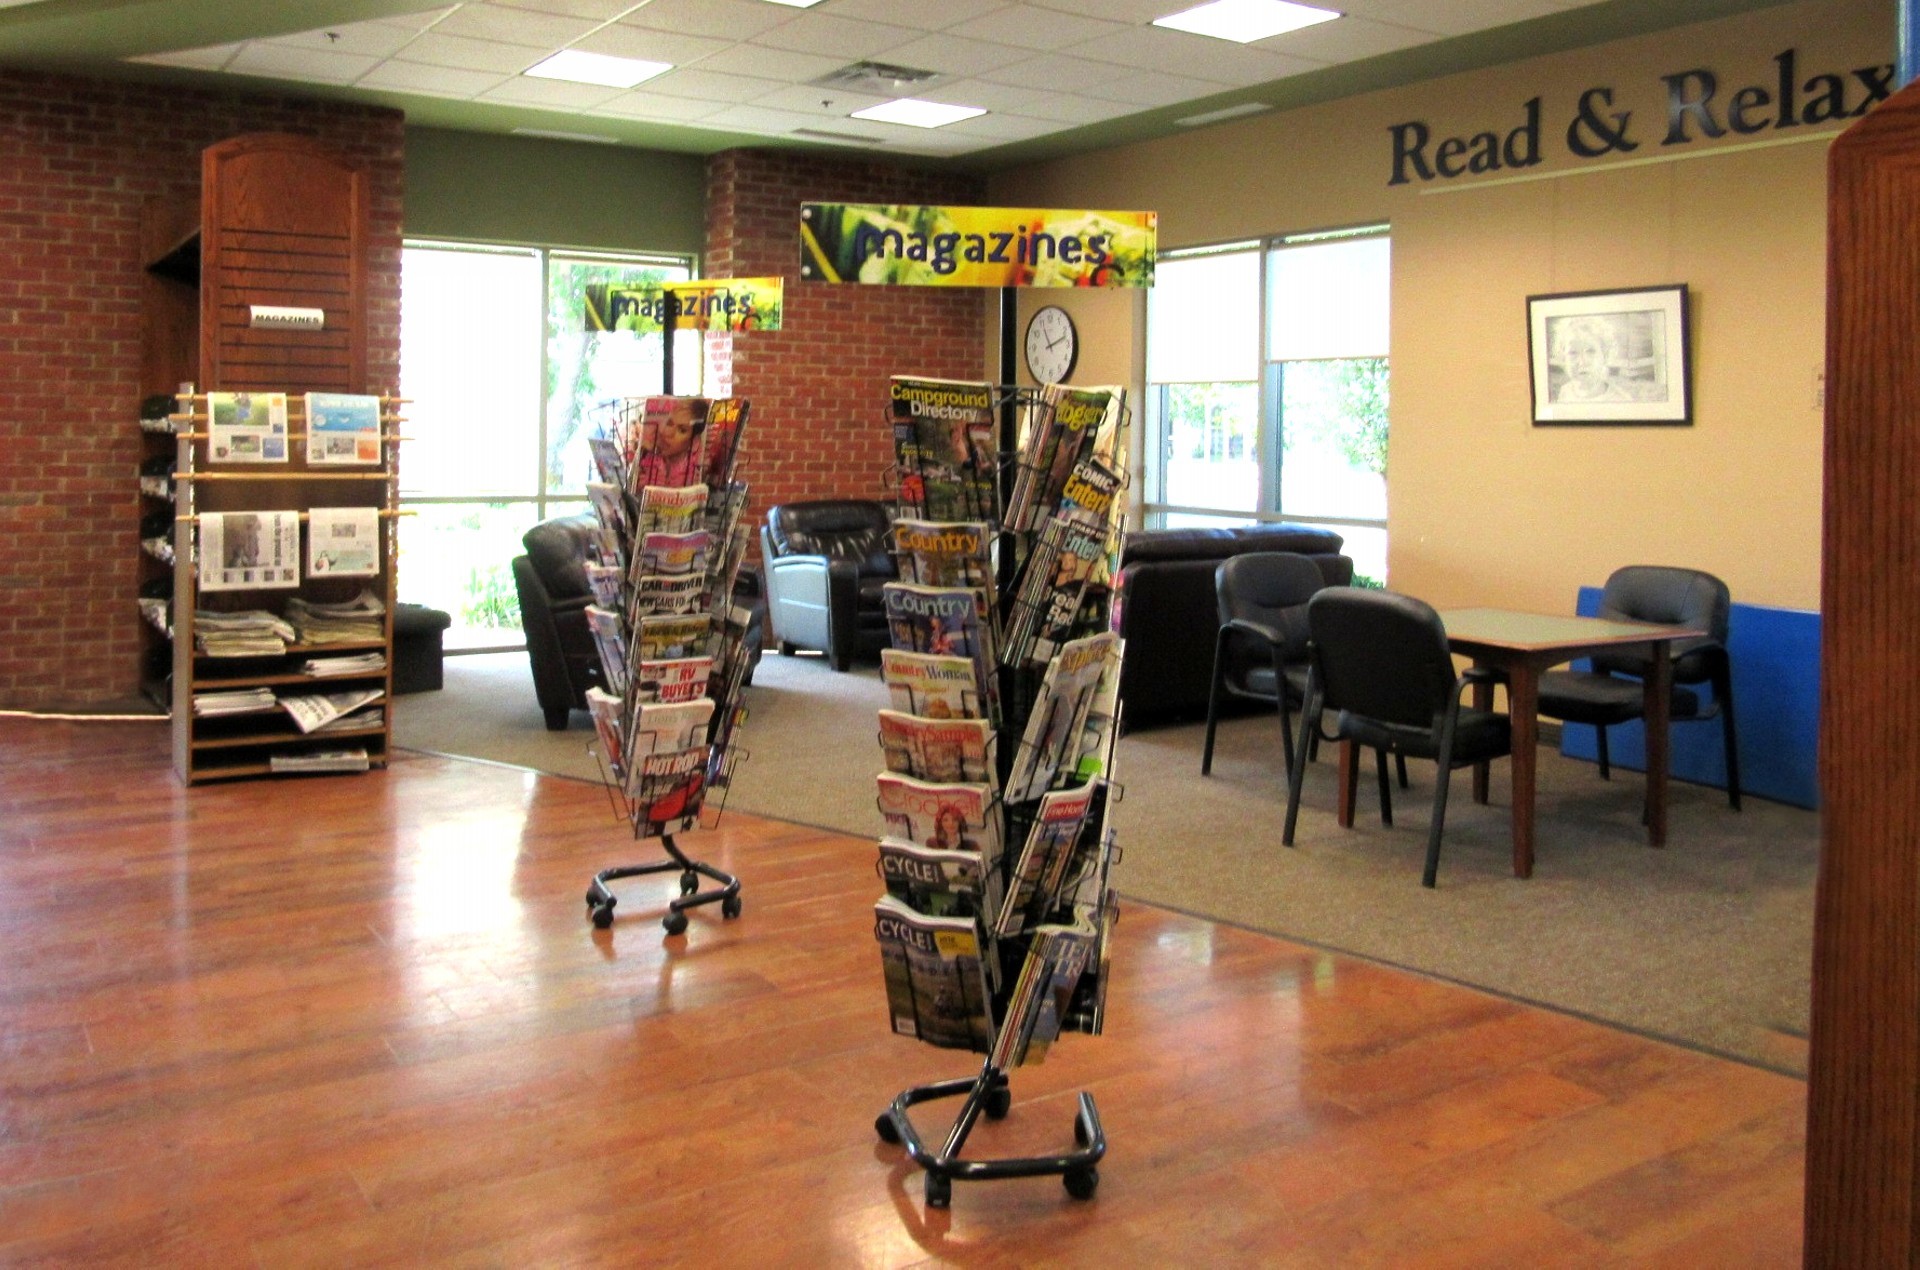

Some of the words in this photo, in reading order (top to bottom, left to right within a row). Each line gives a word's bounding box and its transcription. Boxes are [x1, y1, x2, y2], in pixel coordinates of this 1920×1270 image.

[1387, 97, 1543, 186] Read
[1566, 87, 1638, 158] &
[1660, 48, 1896, 147] Relax
[856, 225, 1107, 276] magazines
[255, 314, 319, 325] MAGAZINES
[890, 384, 988, 408] Campground
[911, 400, 977, 422] Directory
[896, 527, 977, 554] Country
[889, 590, 969, 617] Country
